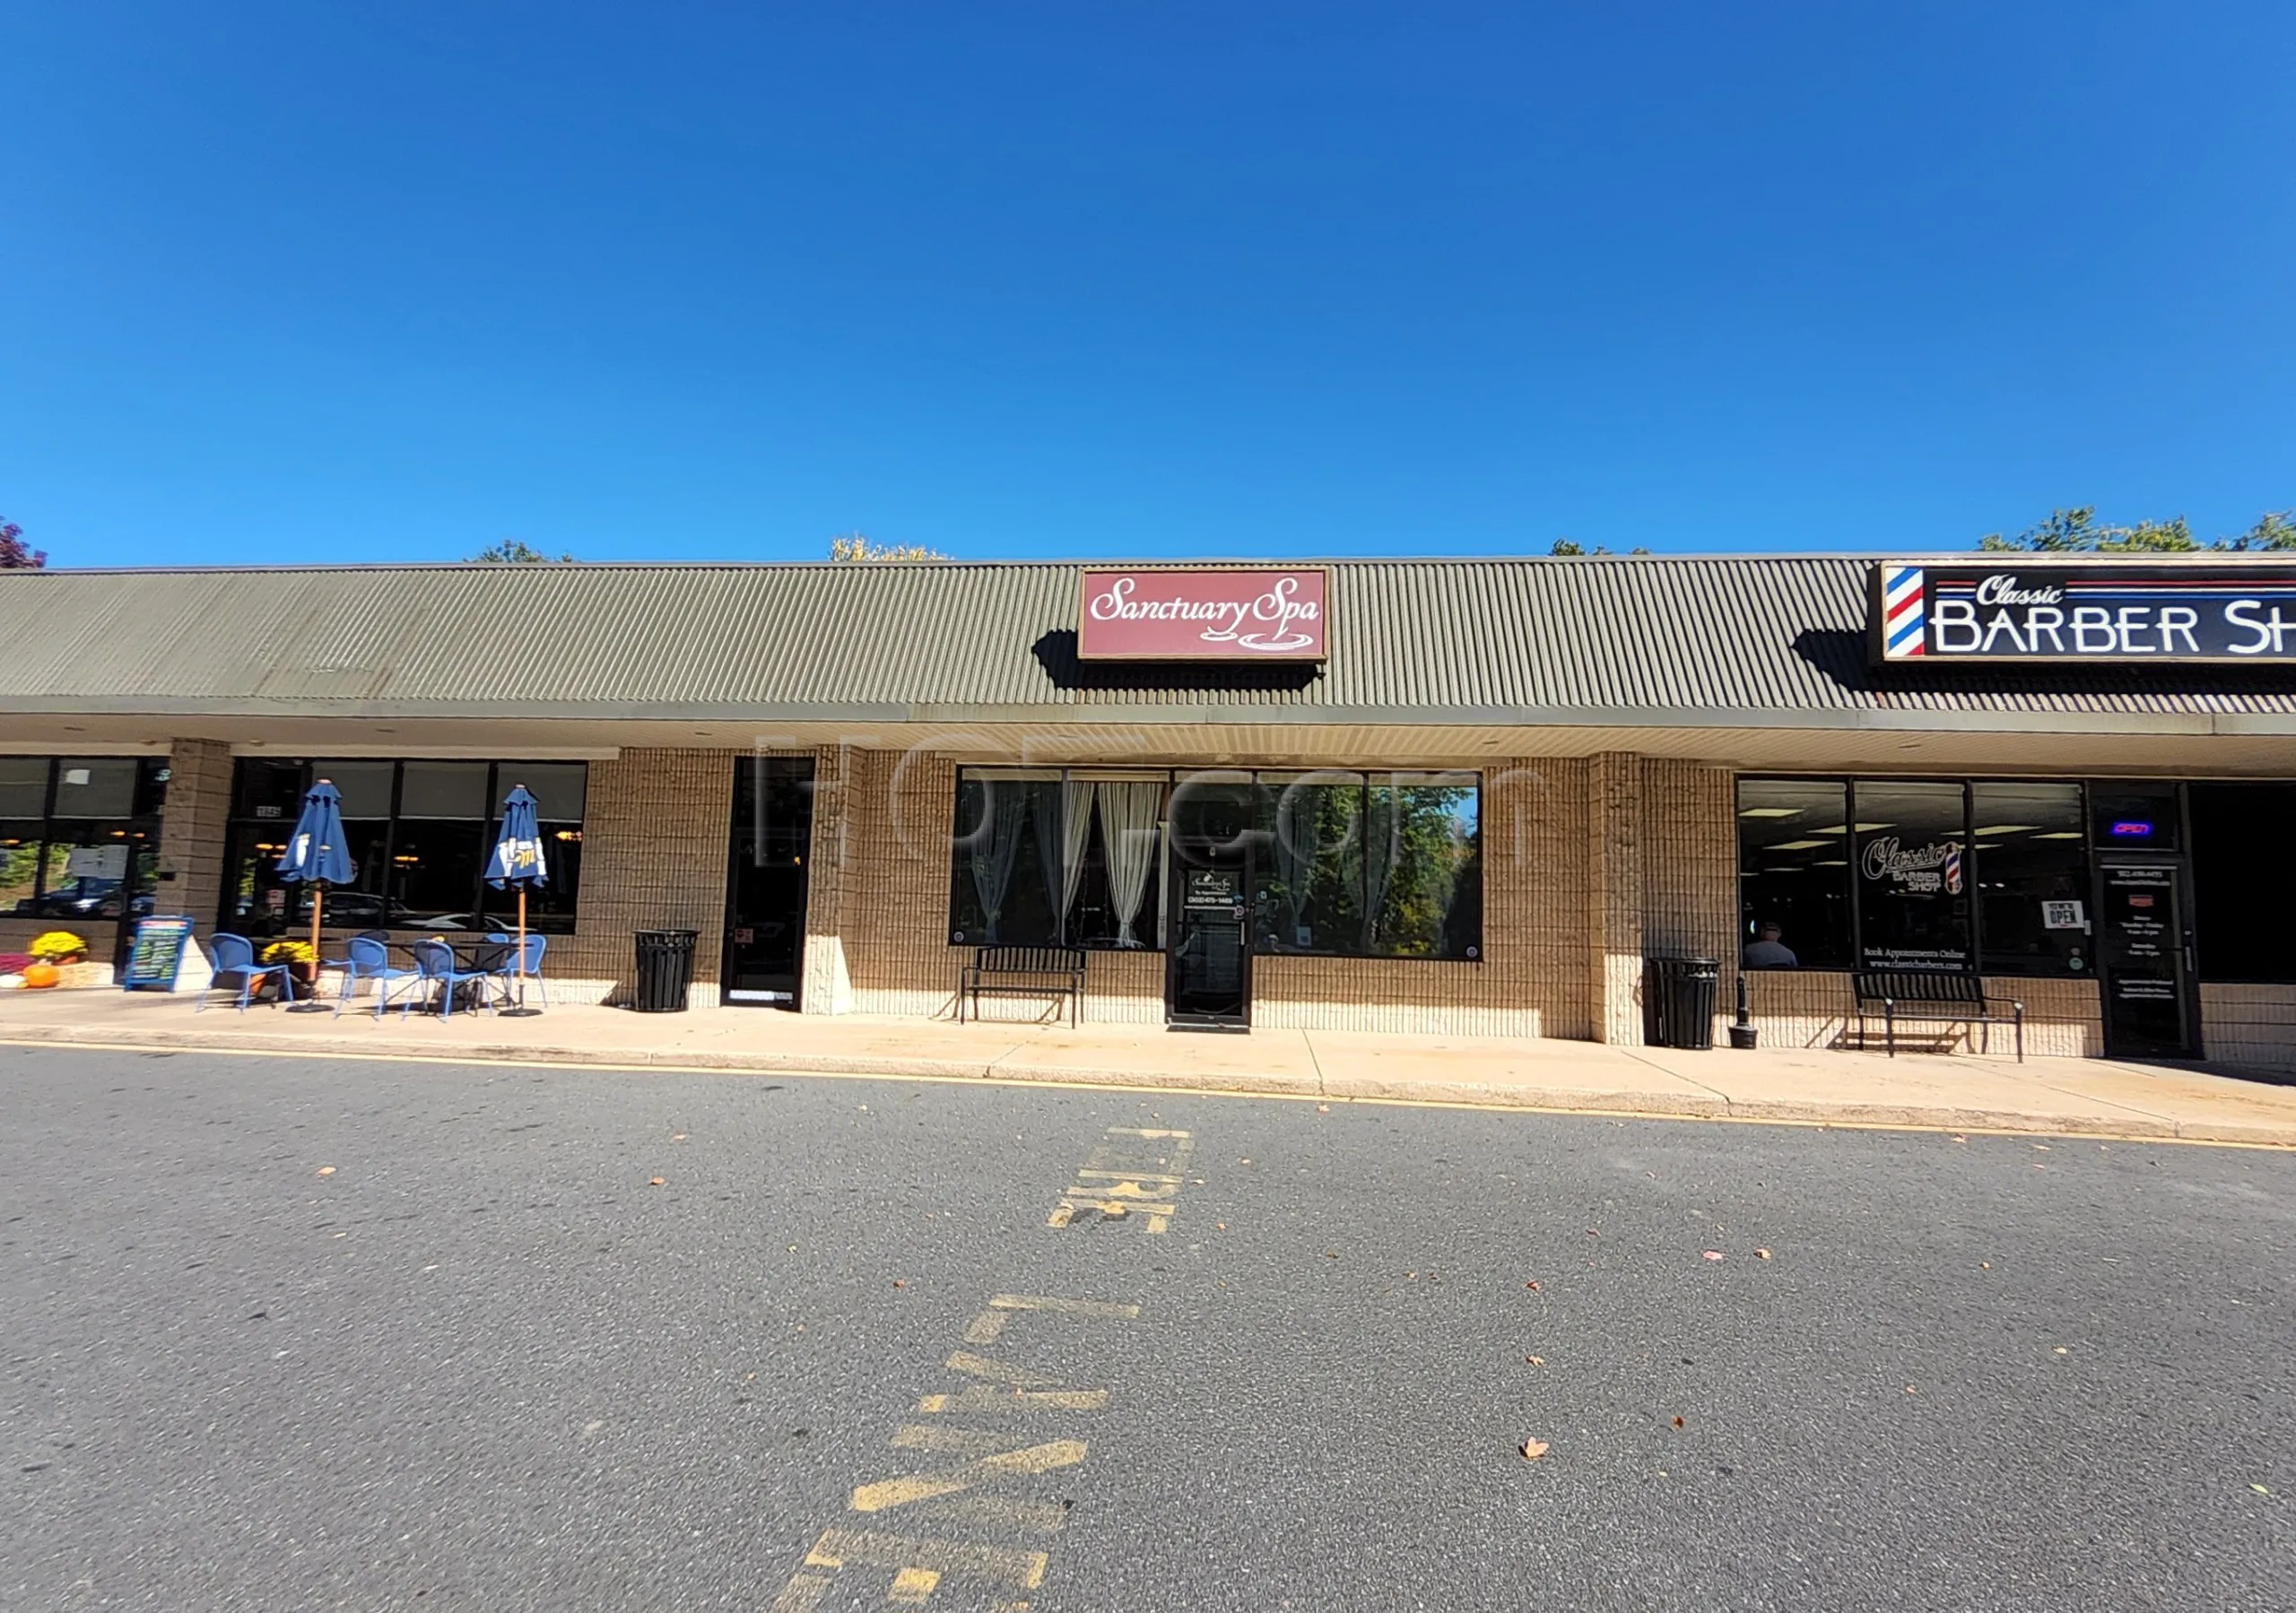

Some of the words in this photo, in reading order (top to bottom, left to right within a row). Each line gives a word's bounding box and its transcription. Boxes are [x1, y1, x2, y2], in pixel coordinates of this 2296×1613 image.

[1977, 574, 2063, 606] Classic
[1091, 577, 1251, 633] Sanctuary
[1253, 577, 1319, 640] Spa
[1929, 600, 2200, 653] BARBER
[1862, 837, 1946, 880] Classic
[1892, 872, 1941, 881] BARBER
[1908, 881, 1942, 892] SHOP
[2050, 910, 2077, 924] OPEN
[1864, 947, 1883, 956] Book
